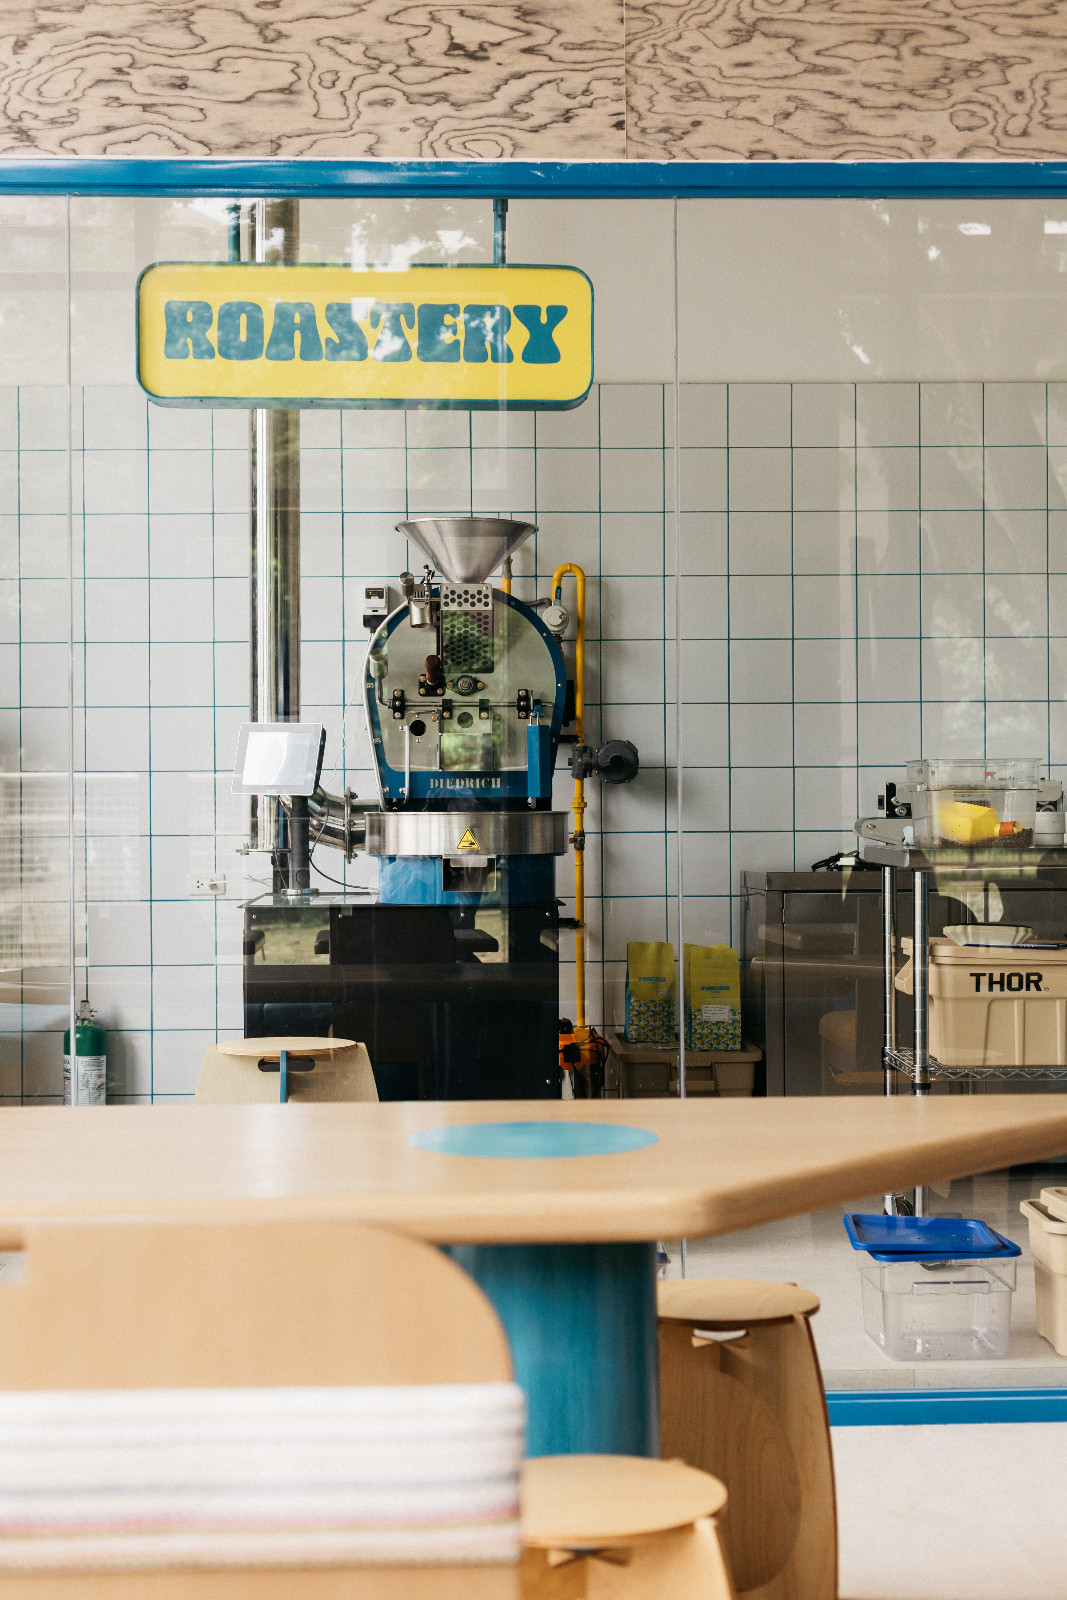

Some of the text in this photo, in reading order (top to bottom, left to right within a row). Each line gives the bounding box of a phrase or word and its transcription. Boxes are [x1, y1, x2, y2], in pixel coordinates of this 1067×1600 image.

[164, 300, 569, 364] ROASTERY
[429, 777, 501, 789] DIEDRICH
[969, 972, 1043, 992] THOR
